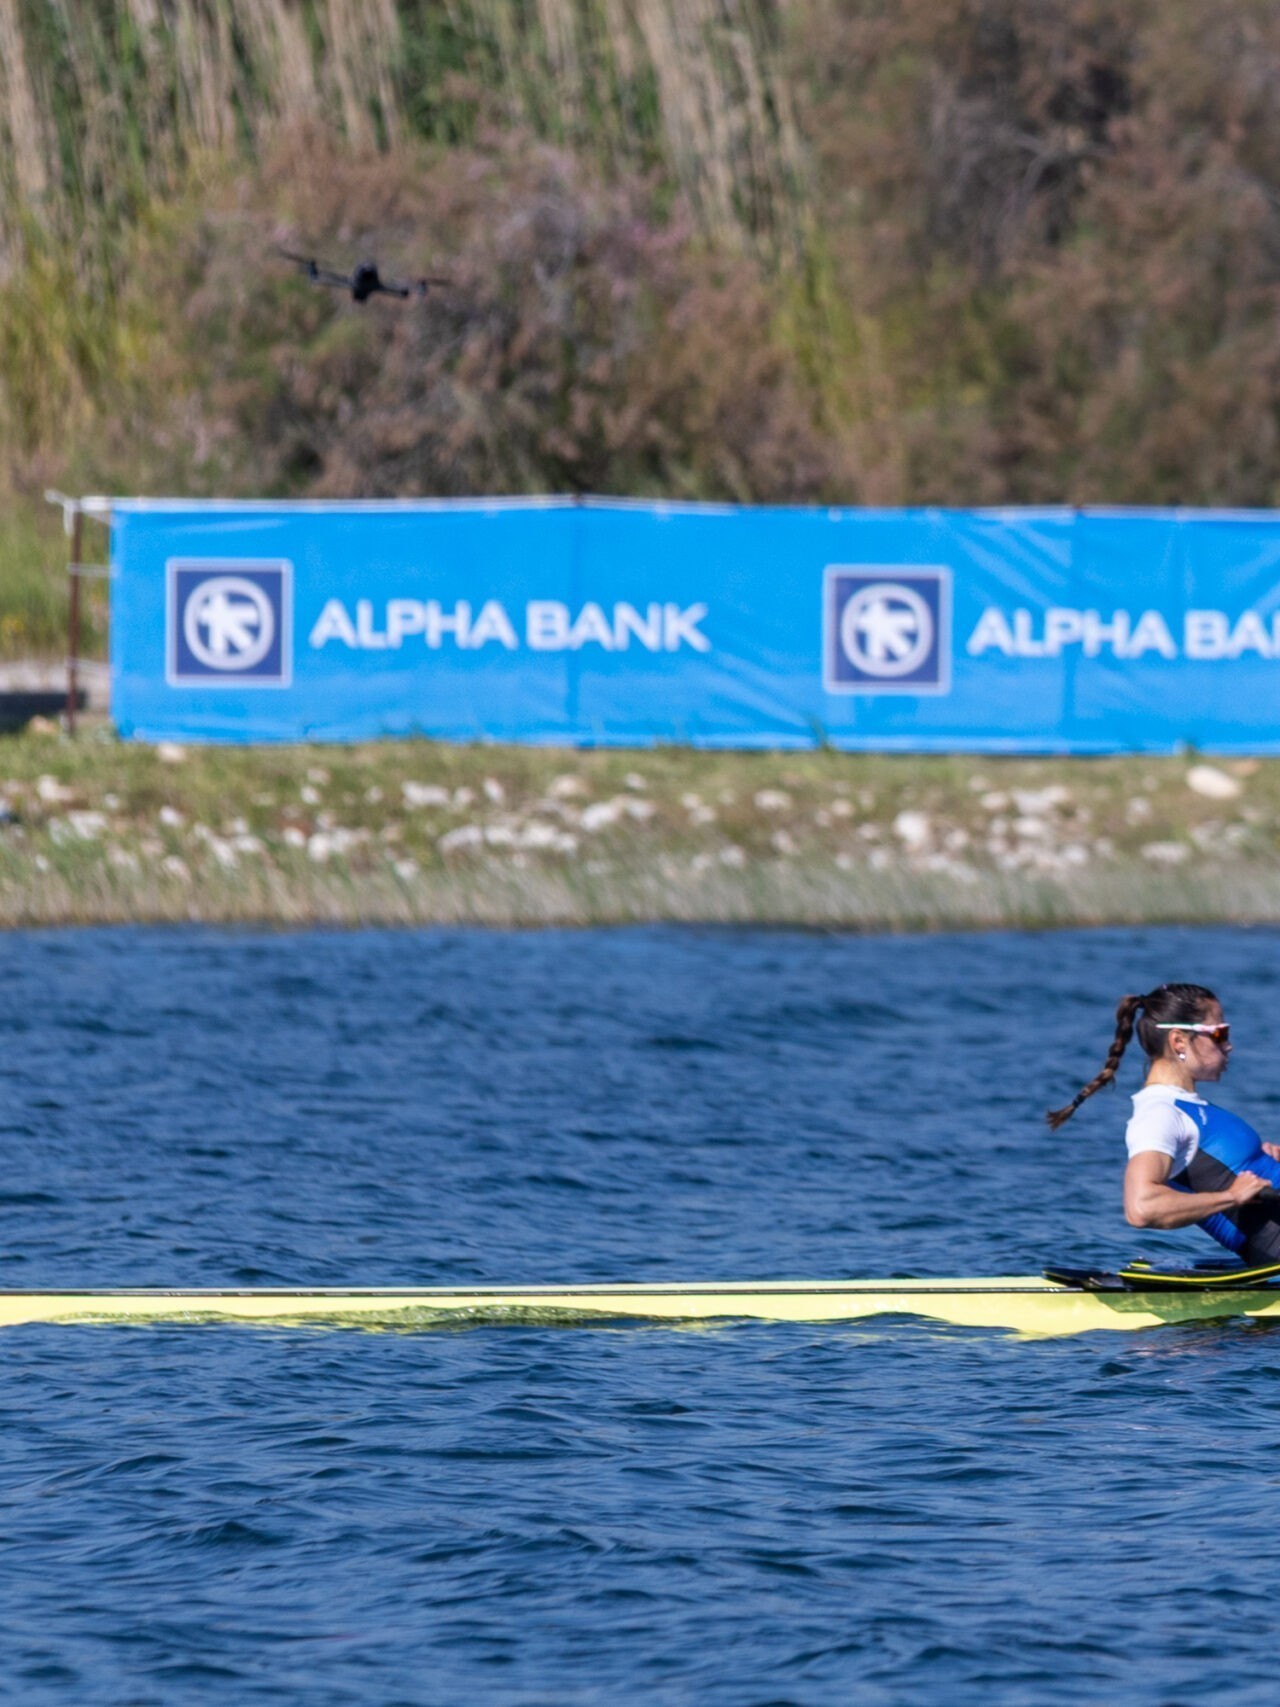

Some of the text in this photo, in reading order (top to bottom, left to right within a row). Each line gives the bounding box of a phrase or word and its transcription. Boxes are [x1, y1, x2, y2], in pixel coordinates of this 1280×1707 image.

[310, 599, 710, 652] ALPHA BANK
[967, 607, 1178, 658] ALPHA
